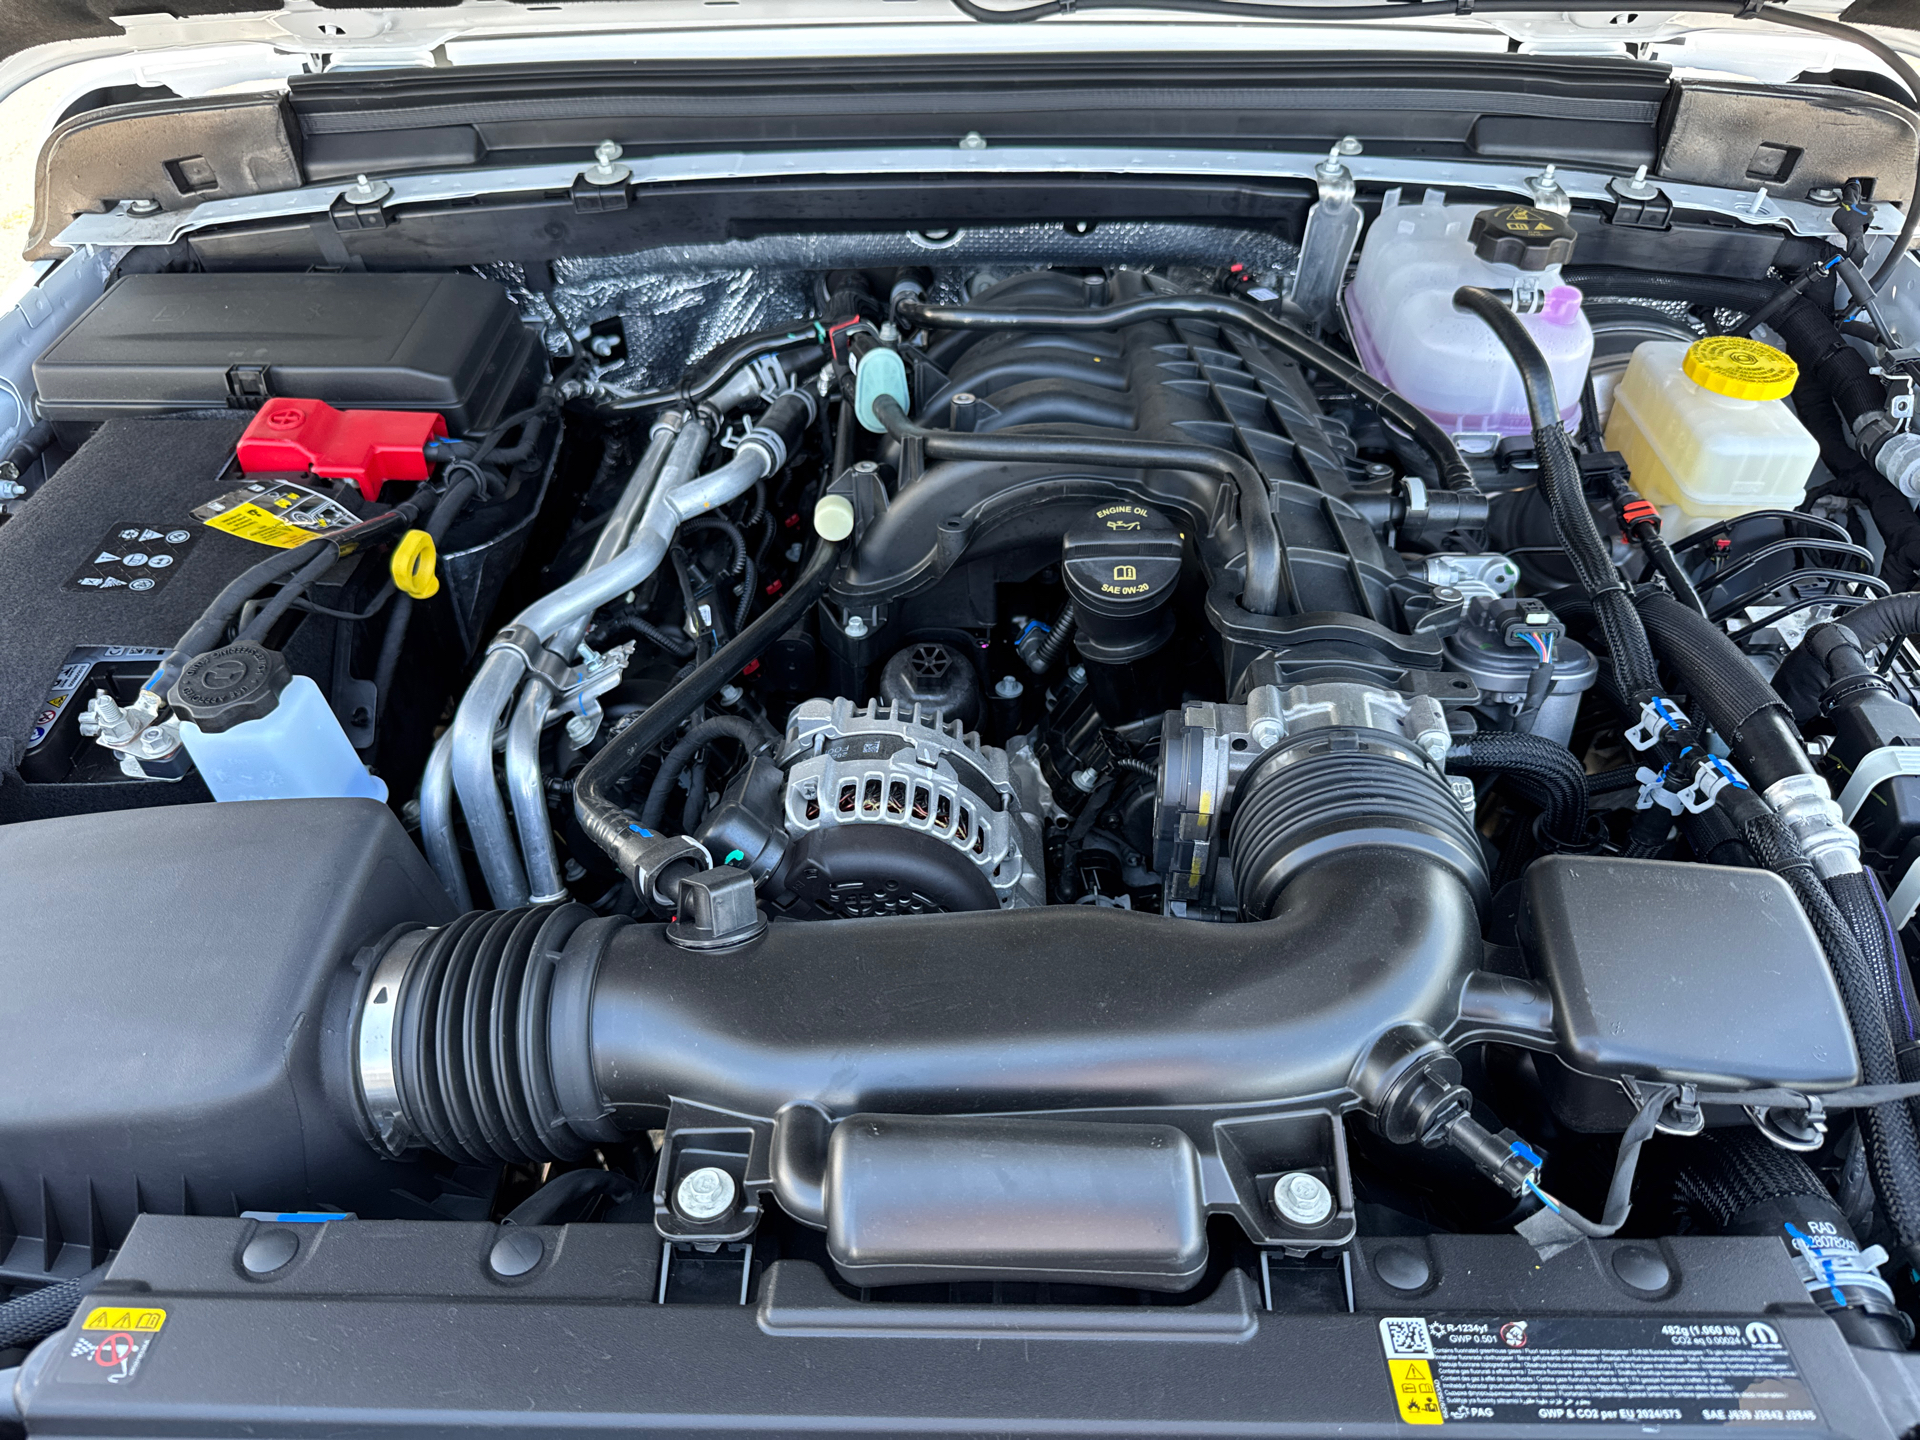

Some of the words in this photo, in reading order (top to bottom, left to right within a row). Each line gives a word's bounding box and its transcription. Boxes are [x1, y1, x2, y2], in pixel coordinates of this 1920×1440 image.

[1096, 505, 1132, 519] ENGINE
[1133, 506, 1149, 518] OIL
[1100, 584, 1121, 595] SAE
[1122, 582, 1150, 595] 0W-20
[1807, 1221, 1837, 1235] RAD
[1446, 1324, 1489, 1334] R-1234yf
[1449, 1334, 1472, 1344] GWP
[1474, 1334, 1498, 1344] 0.501
[1671, 1336, 1692, 1346] CO2
[1470, 1408, 1494, 1418] PAG
[1538, 1408, 1564, 1418] GWP
[1566, 1408, 1575, 1418] &
[1576, 1408, 1600, 1418] CO2
[1600, 1410, 1618, 1420] per
[1618, 1408, 1635, 1418] EU
[1702, 1409, 1726, 1420] SAE
